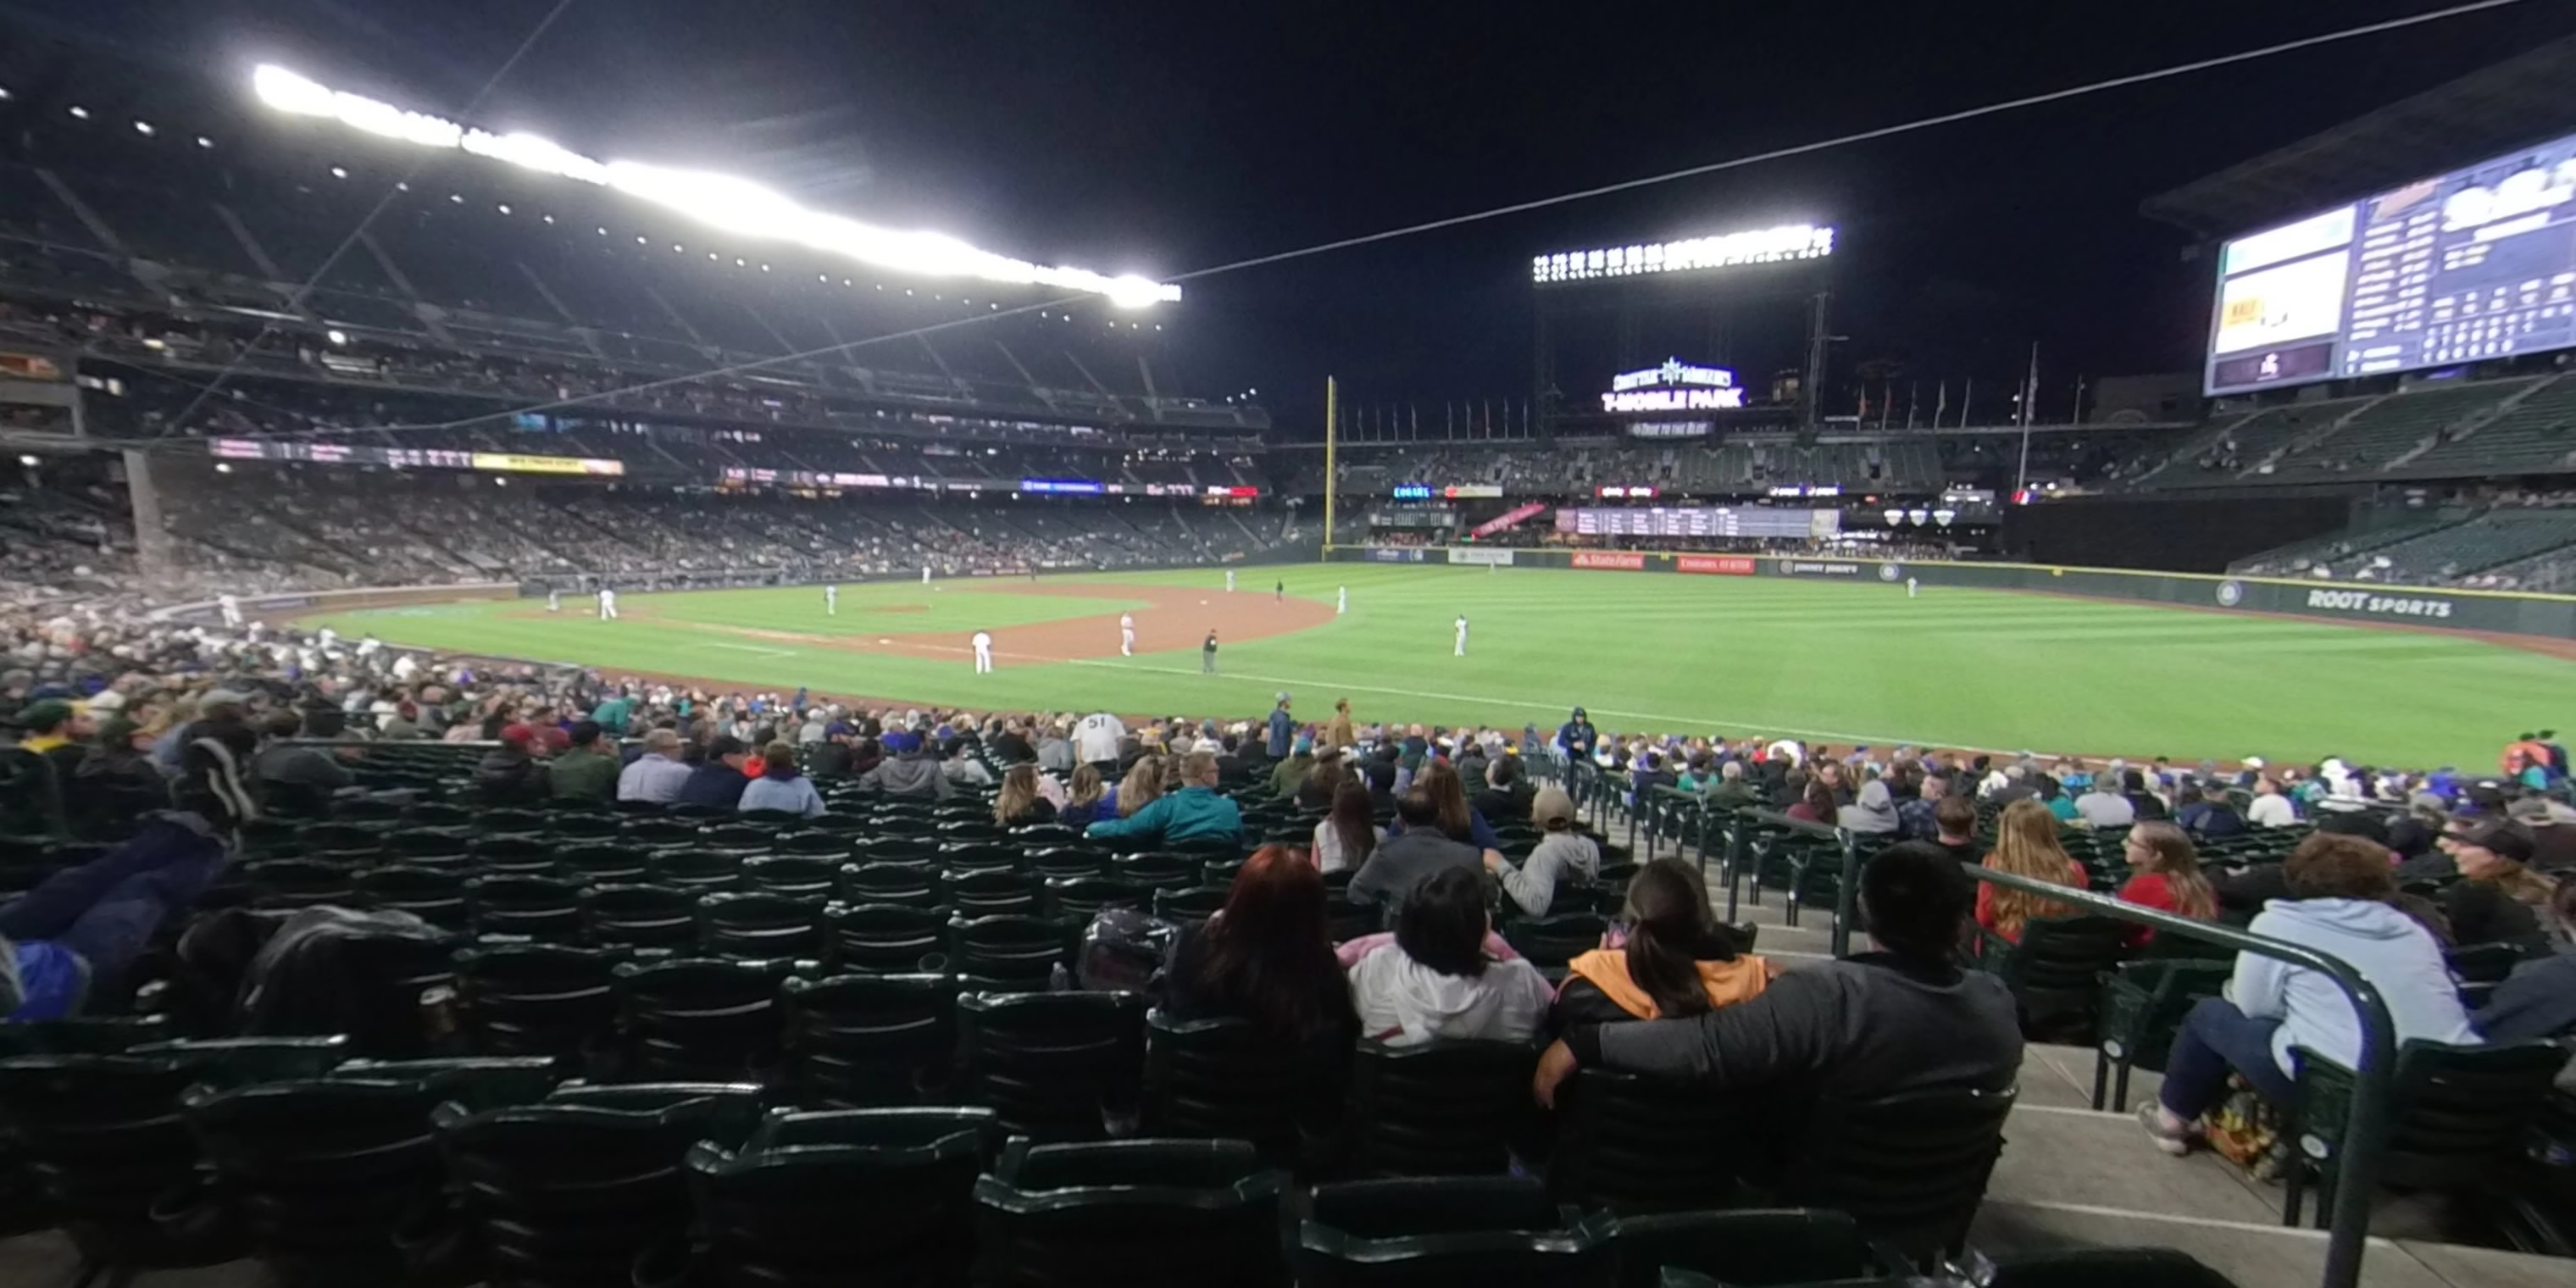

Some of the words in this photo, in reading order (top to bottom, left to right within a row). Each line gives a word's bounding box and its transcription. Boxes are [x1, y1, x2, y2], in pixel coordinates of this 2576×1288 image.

[1602, 391, 1687, 412] T-MOBILE
[1689, 388, 1743, 408] PARK
[1591, 554, 1615, 565] State
[1616, 555, 1641, 567] Farm
[2307, 589, 2369, 610] ROOT
[2369, 597, 2451, 618] SPORTS
[1088, 716, 1105, 729] 51
